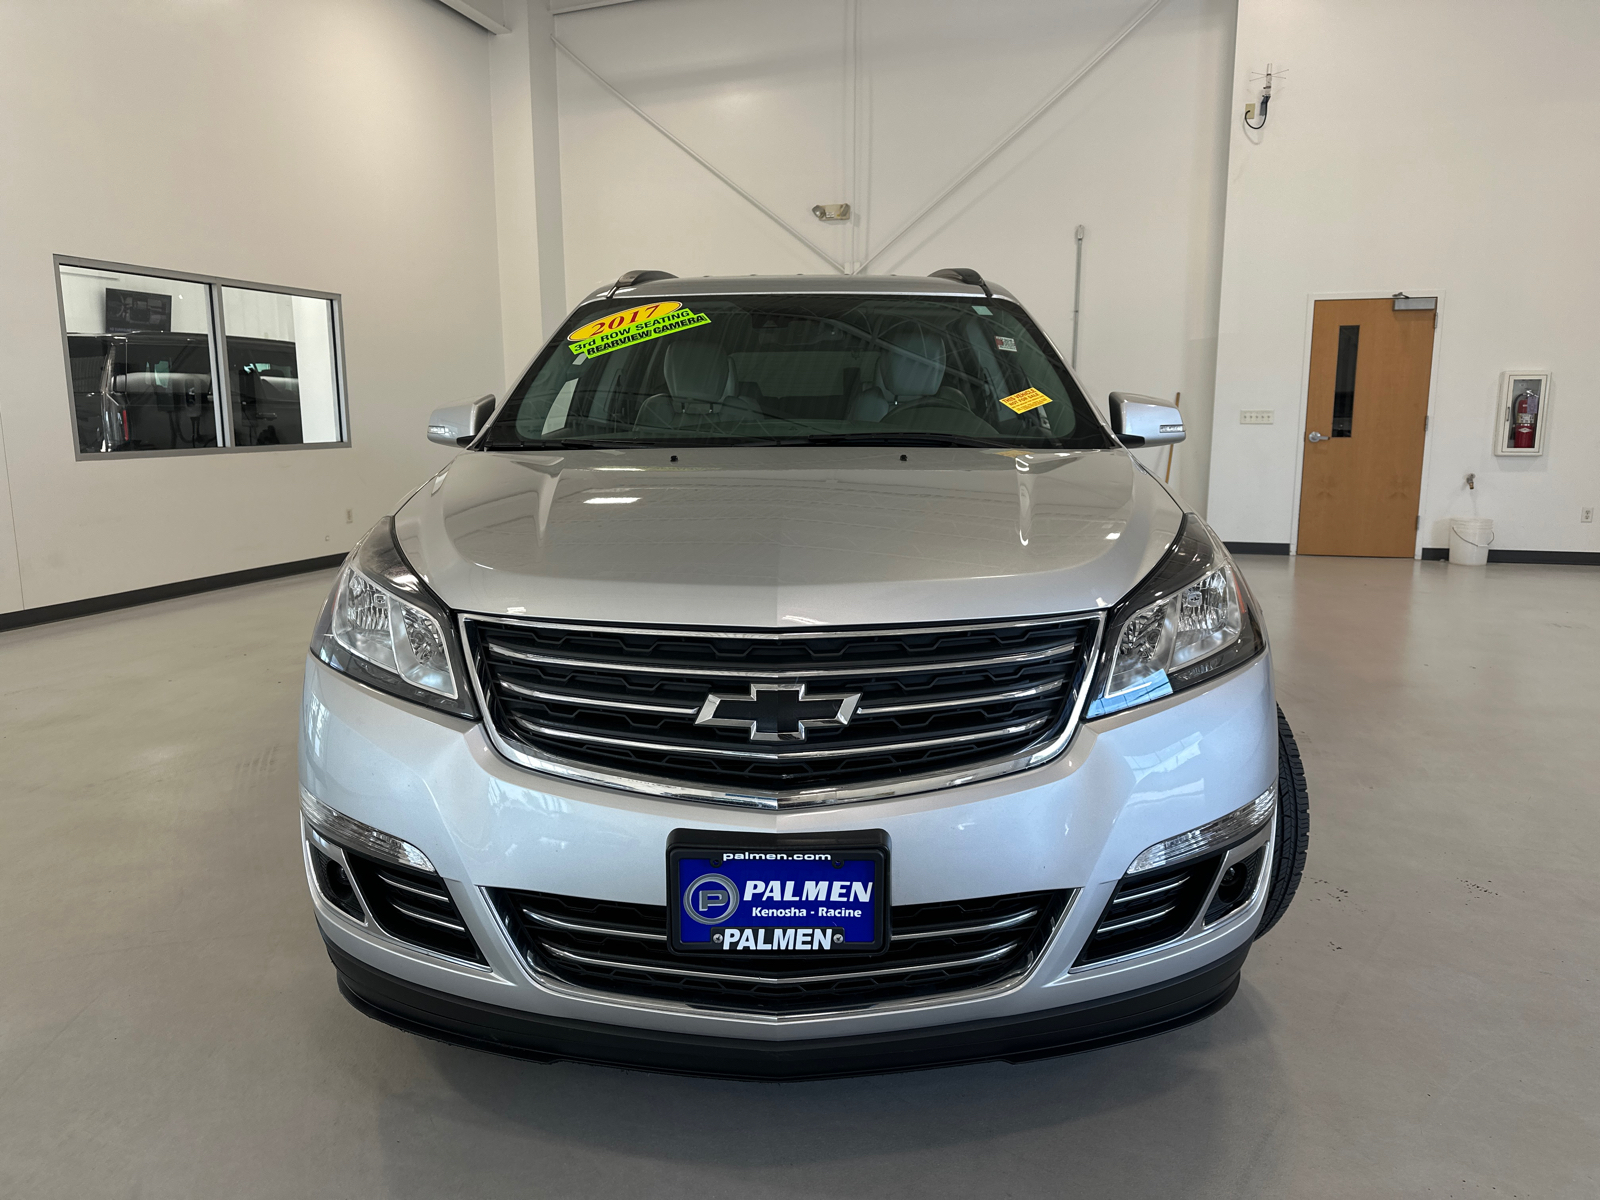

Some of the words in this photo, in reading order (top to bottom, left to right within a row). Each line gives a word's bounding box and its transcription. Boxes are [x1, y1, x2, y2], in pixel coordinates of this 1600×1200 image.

[574, 339, 596, 352] 3rd
[600, 327, 631, 343] ROW
[635, 310, 690, 331] SEATING
[590, 304, 661, 337] 2017
[586, 329, 652, 356] REARVIEW
[653, 315, 707, 334] CAMERA
[723, 852, 832, 861] palmen.com
[743, 880, 873, 903] PALMEN
[752, 907, 807, 917] Kenosha
[818, 907, 862, 917] Racine
[723, 928, 832, 950] PALMEN
